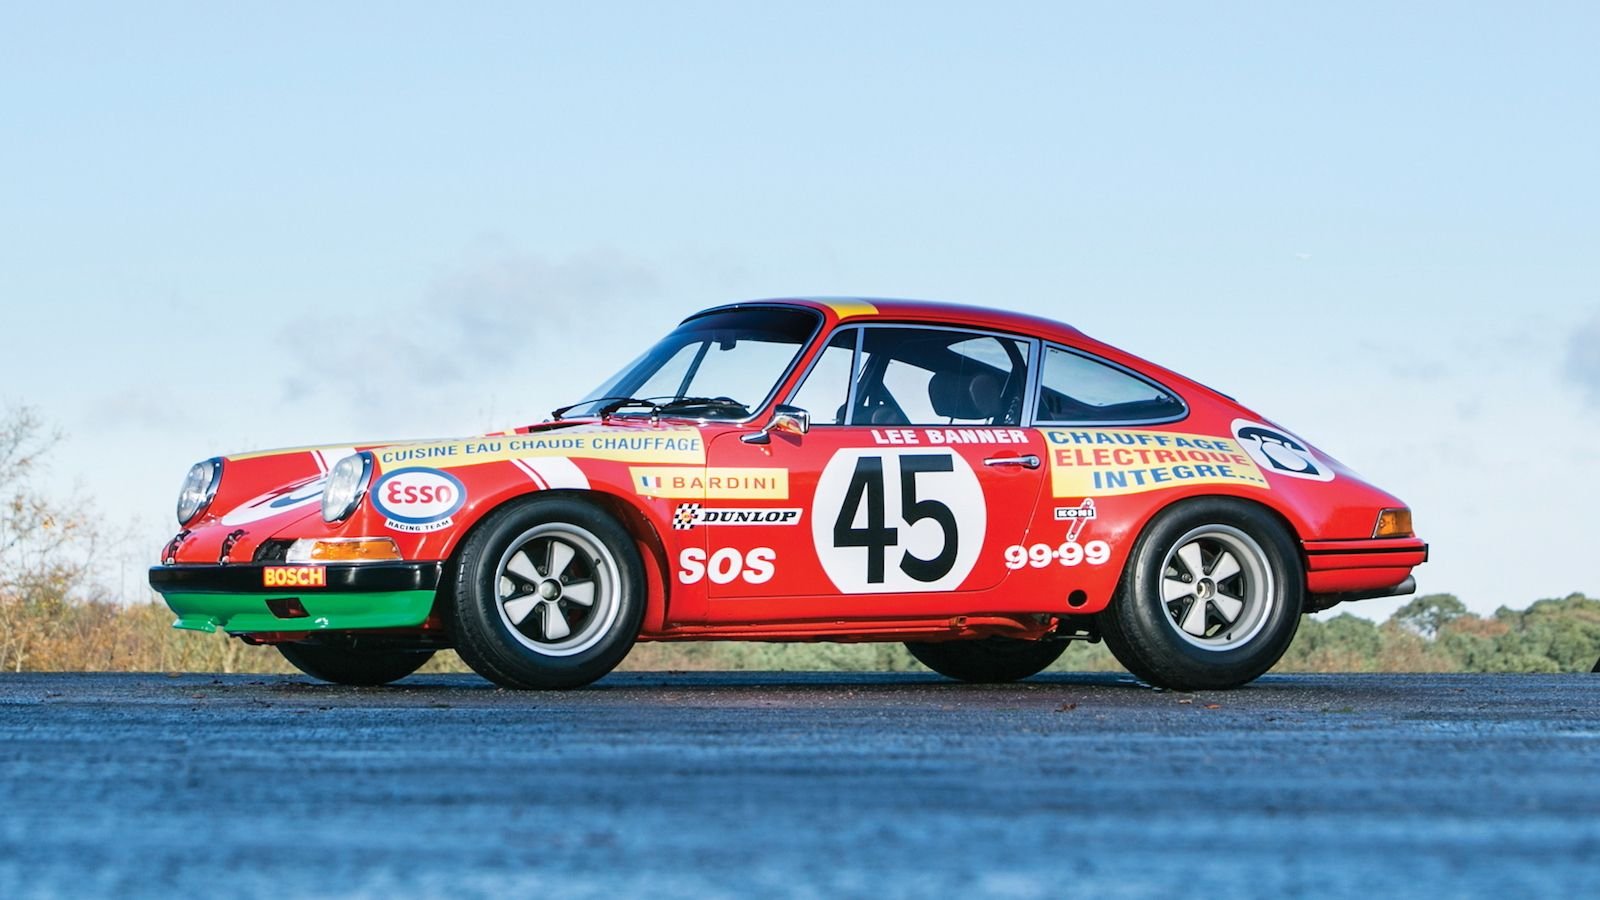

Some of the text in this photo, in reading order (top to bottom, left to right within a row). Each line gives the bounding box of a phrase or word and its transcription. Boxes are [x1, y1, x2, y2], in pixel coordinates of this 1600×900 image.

[871, 430, 1029, 445] LEE BANNER
[1047, 431, 1233, 453] CHAUFFAGE
[382, 437, 700, 463] CUISINE EAU CHAUDE CHAUFFAGE
[1055, 448, 1251, 467] ELECTRIQUE
[673, 476, 776, 489] BARDINI
[1092, 464, 1265, 490] INTEGRE...
[701, 511, 797, 522] DUNLOP
[833, 454, 959, 584] 45
[1057, 509, 1093, 517] KONI
[388, 520, 450, 531] RACING TEAM
[678, 547, 777, 585] SOS
[264, 566, 324, 586] BOSCH
